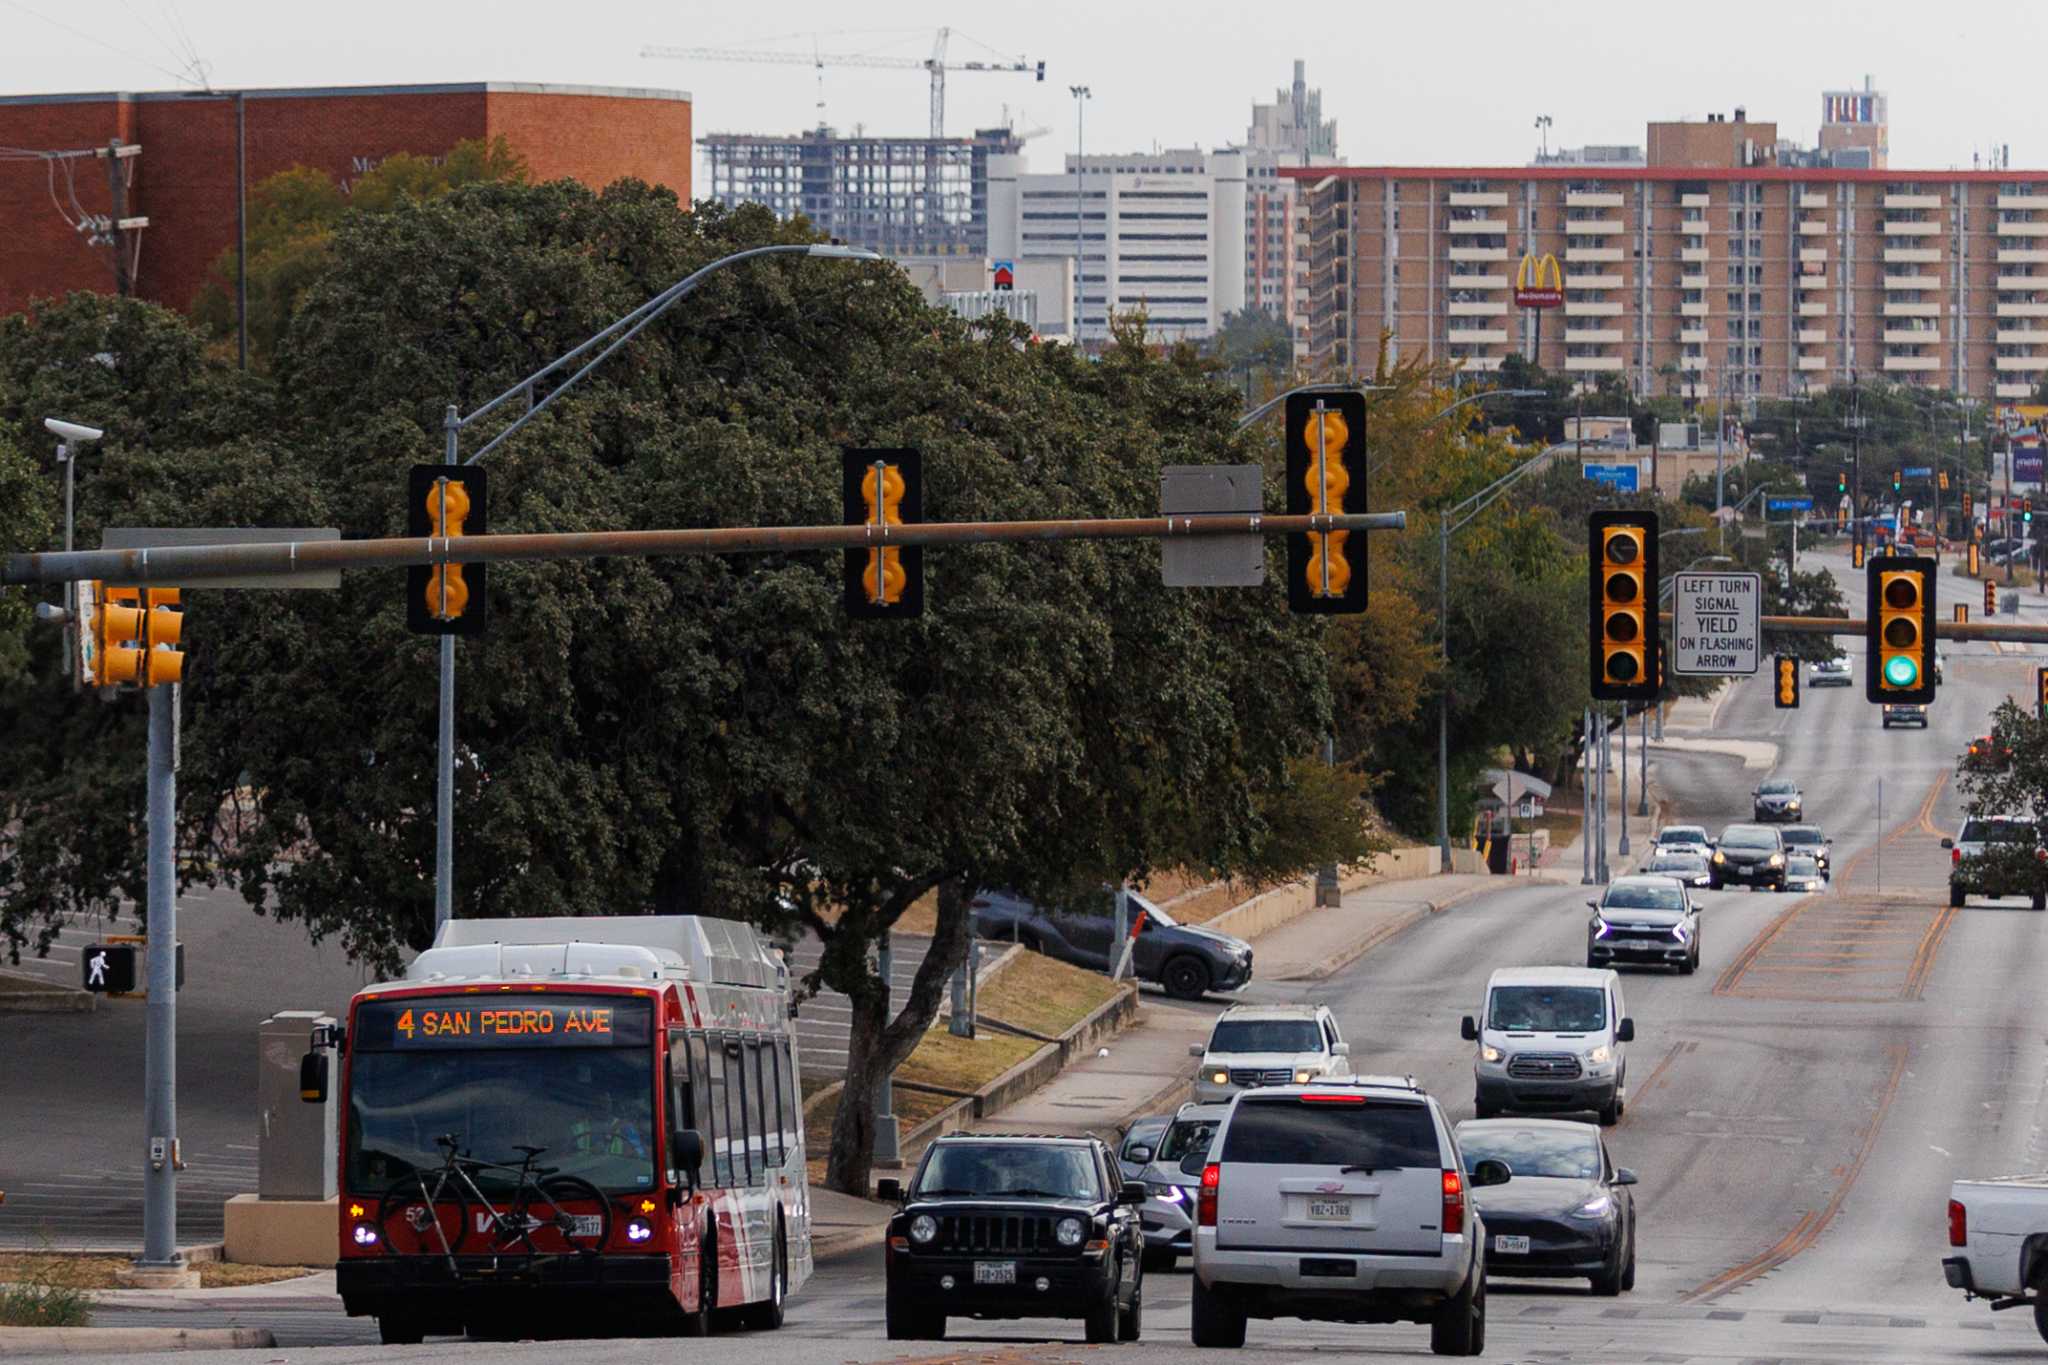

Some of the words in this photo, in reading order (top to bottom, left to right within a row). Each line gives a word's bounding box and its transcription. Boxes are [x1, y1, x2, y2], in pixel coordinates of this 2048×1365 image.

[1684, 580, 1713, 593] LEFT
[1719, 580, 1750, 593] TURN
[1695, 597, 1739, 610] SIGNAL
[1697, 617, 1738, 633] YIELD
[1680, 637, 1695, 650] ON
[1700, 638, 1754, 651] FLASHING
[1696, 655, 1737, 667] ARROW
[397, 1008, 415, 1039] 4
[422, 1010, 471, 1036] SAN
[480, 1009, 554, 1034] PEDRO
[564, 1008, 611, 1033] AVE
